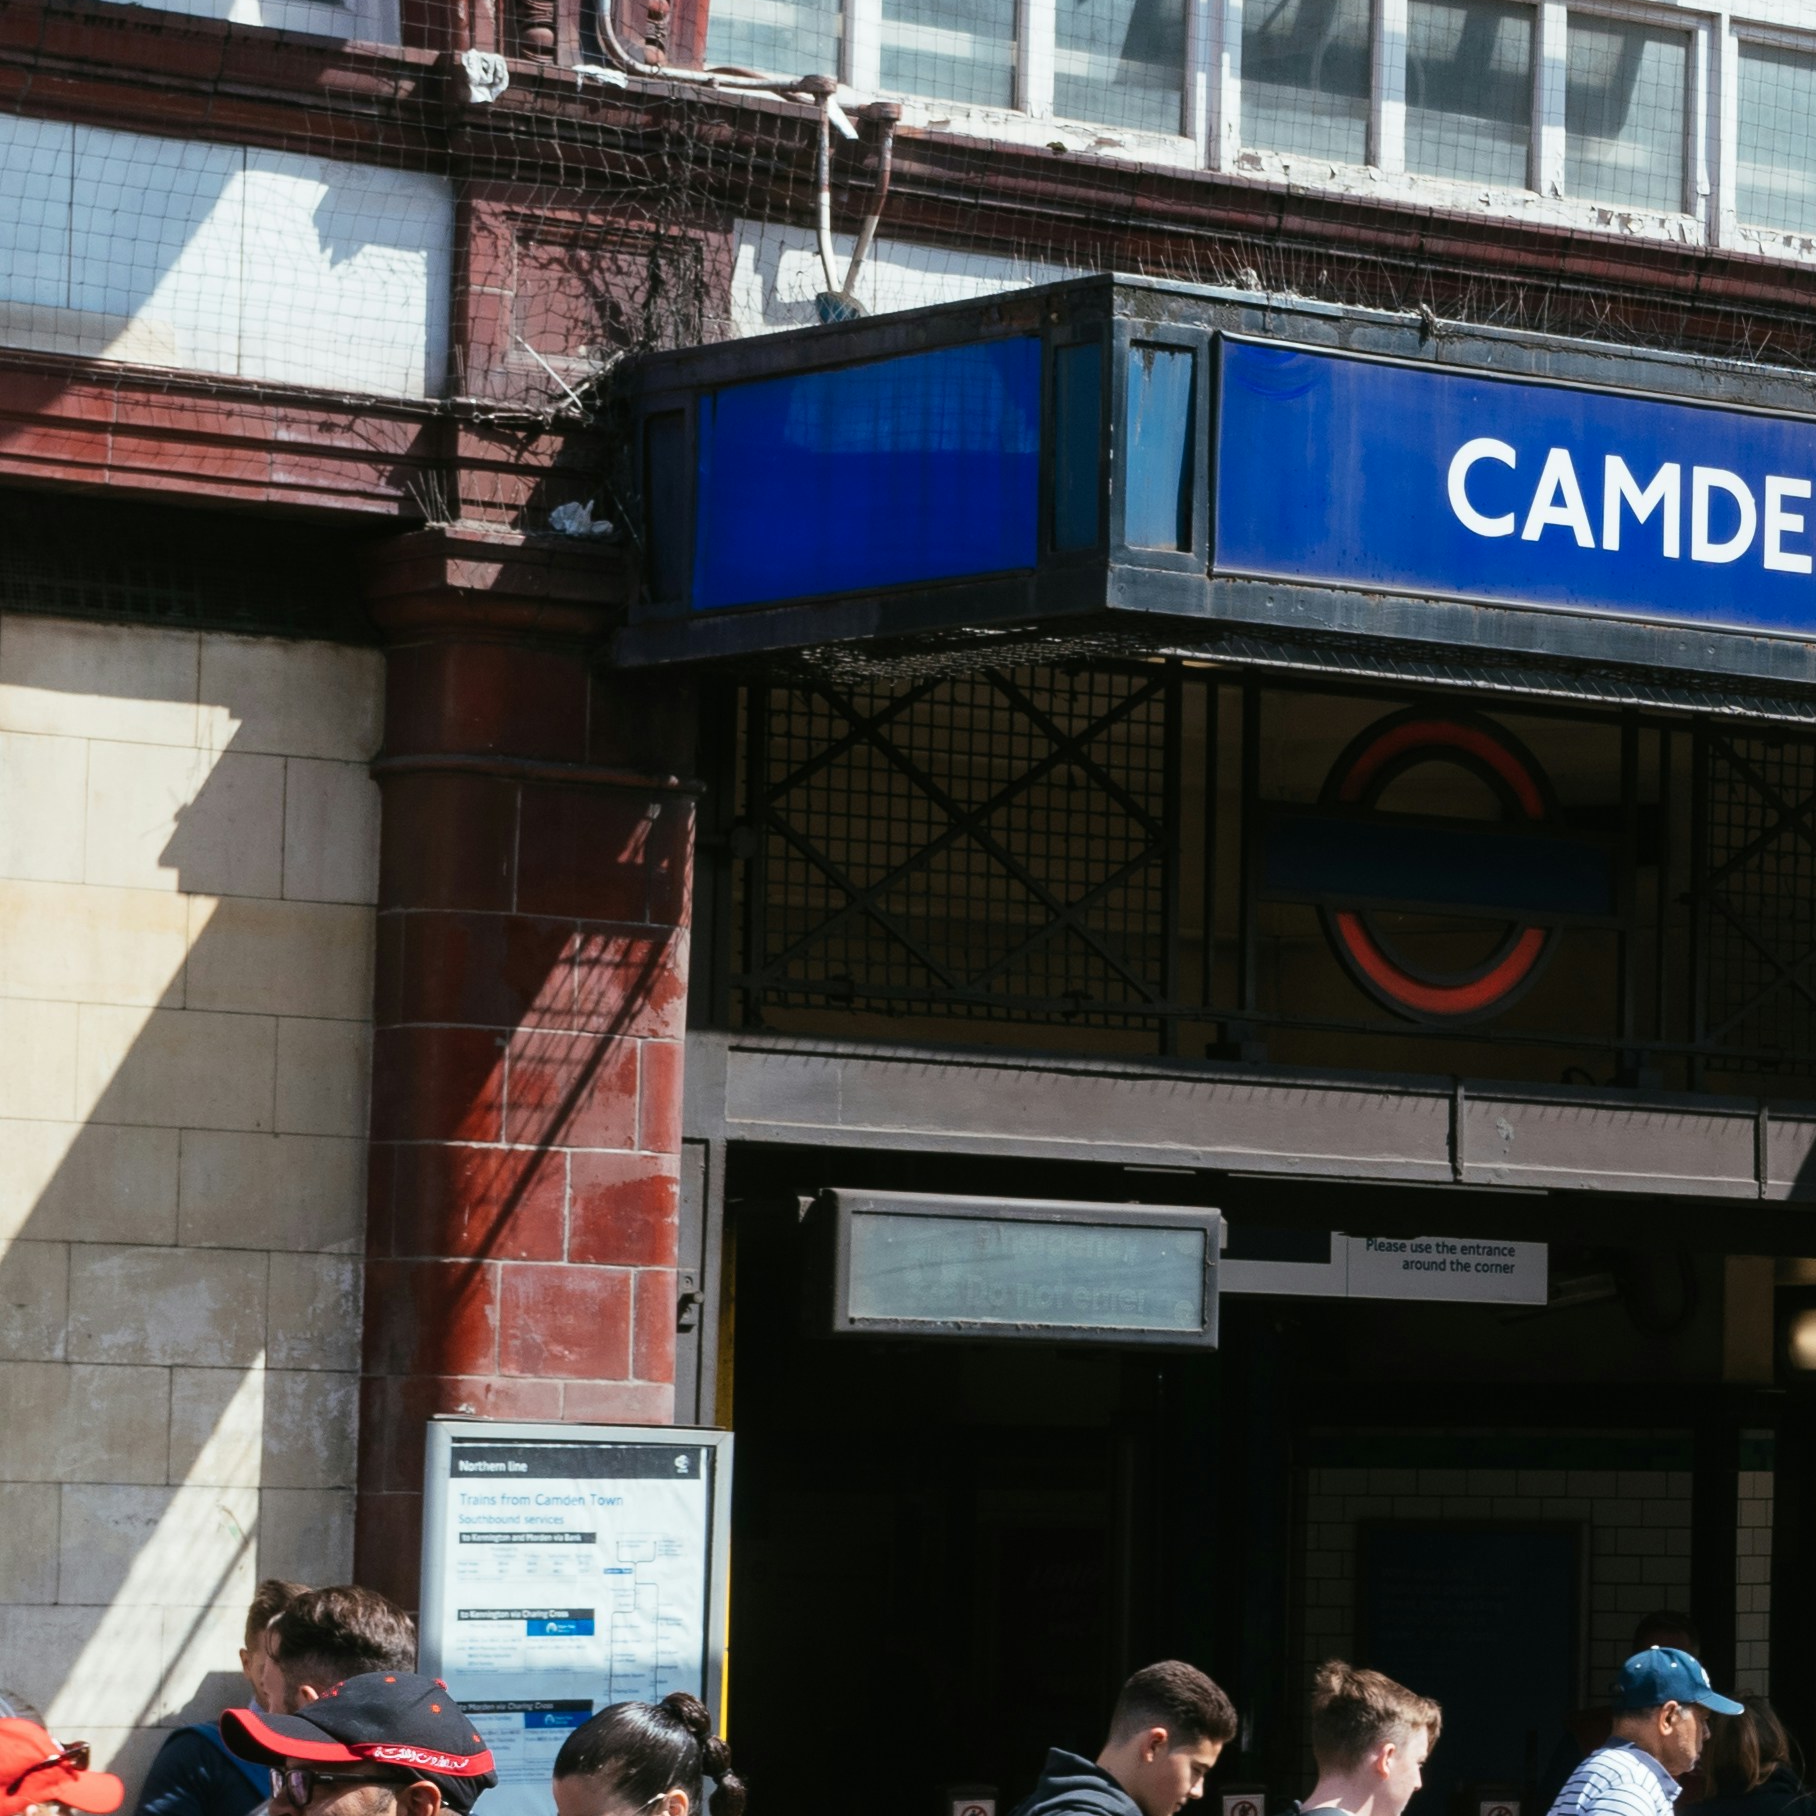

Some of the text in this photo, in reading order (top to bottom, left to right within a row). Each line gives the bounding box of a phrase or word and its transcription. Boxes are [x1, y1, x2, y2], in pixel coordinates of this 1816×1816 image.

[1366, 1239, 1516, 1257] Please use the entrance
[1402, 1259, 1516, 1274] around the corner
[458, 1460, 528, 1473] Northern line
[459, 1493, 624, 1507] Trains from Camden Town
[458, 1514, 565, 1525] Southbound services
